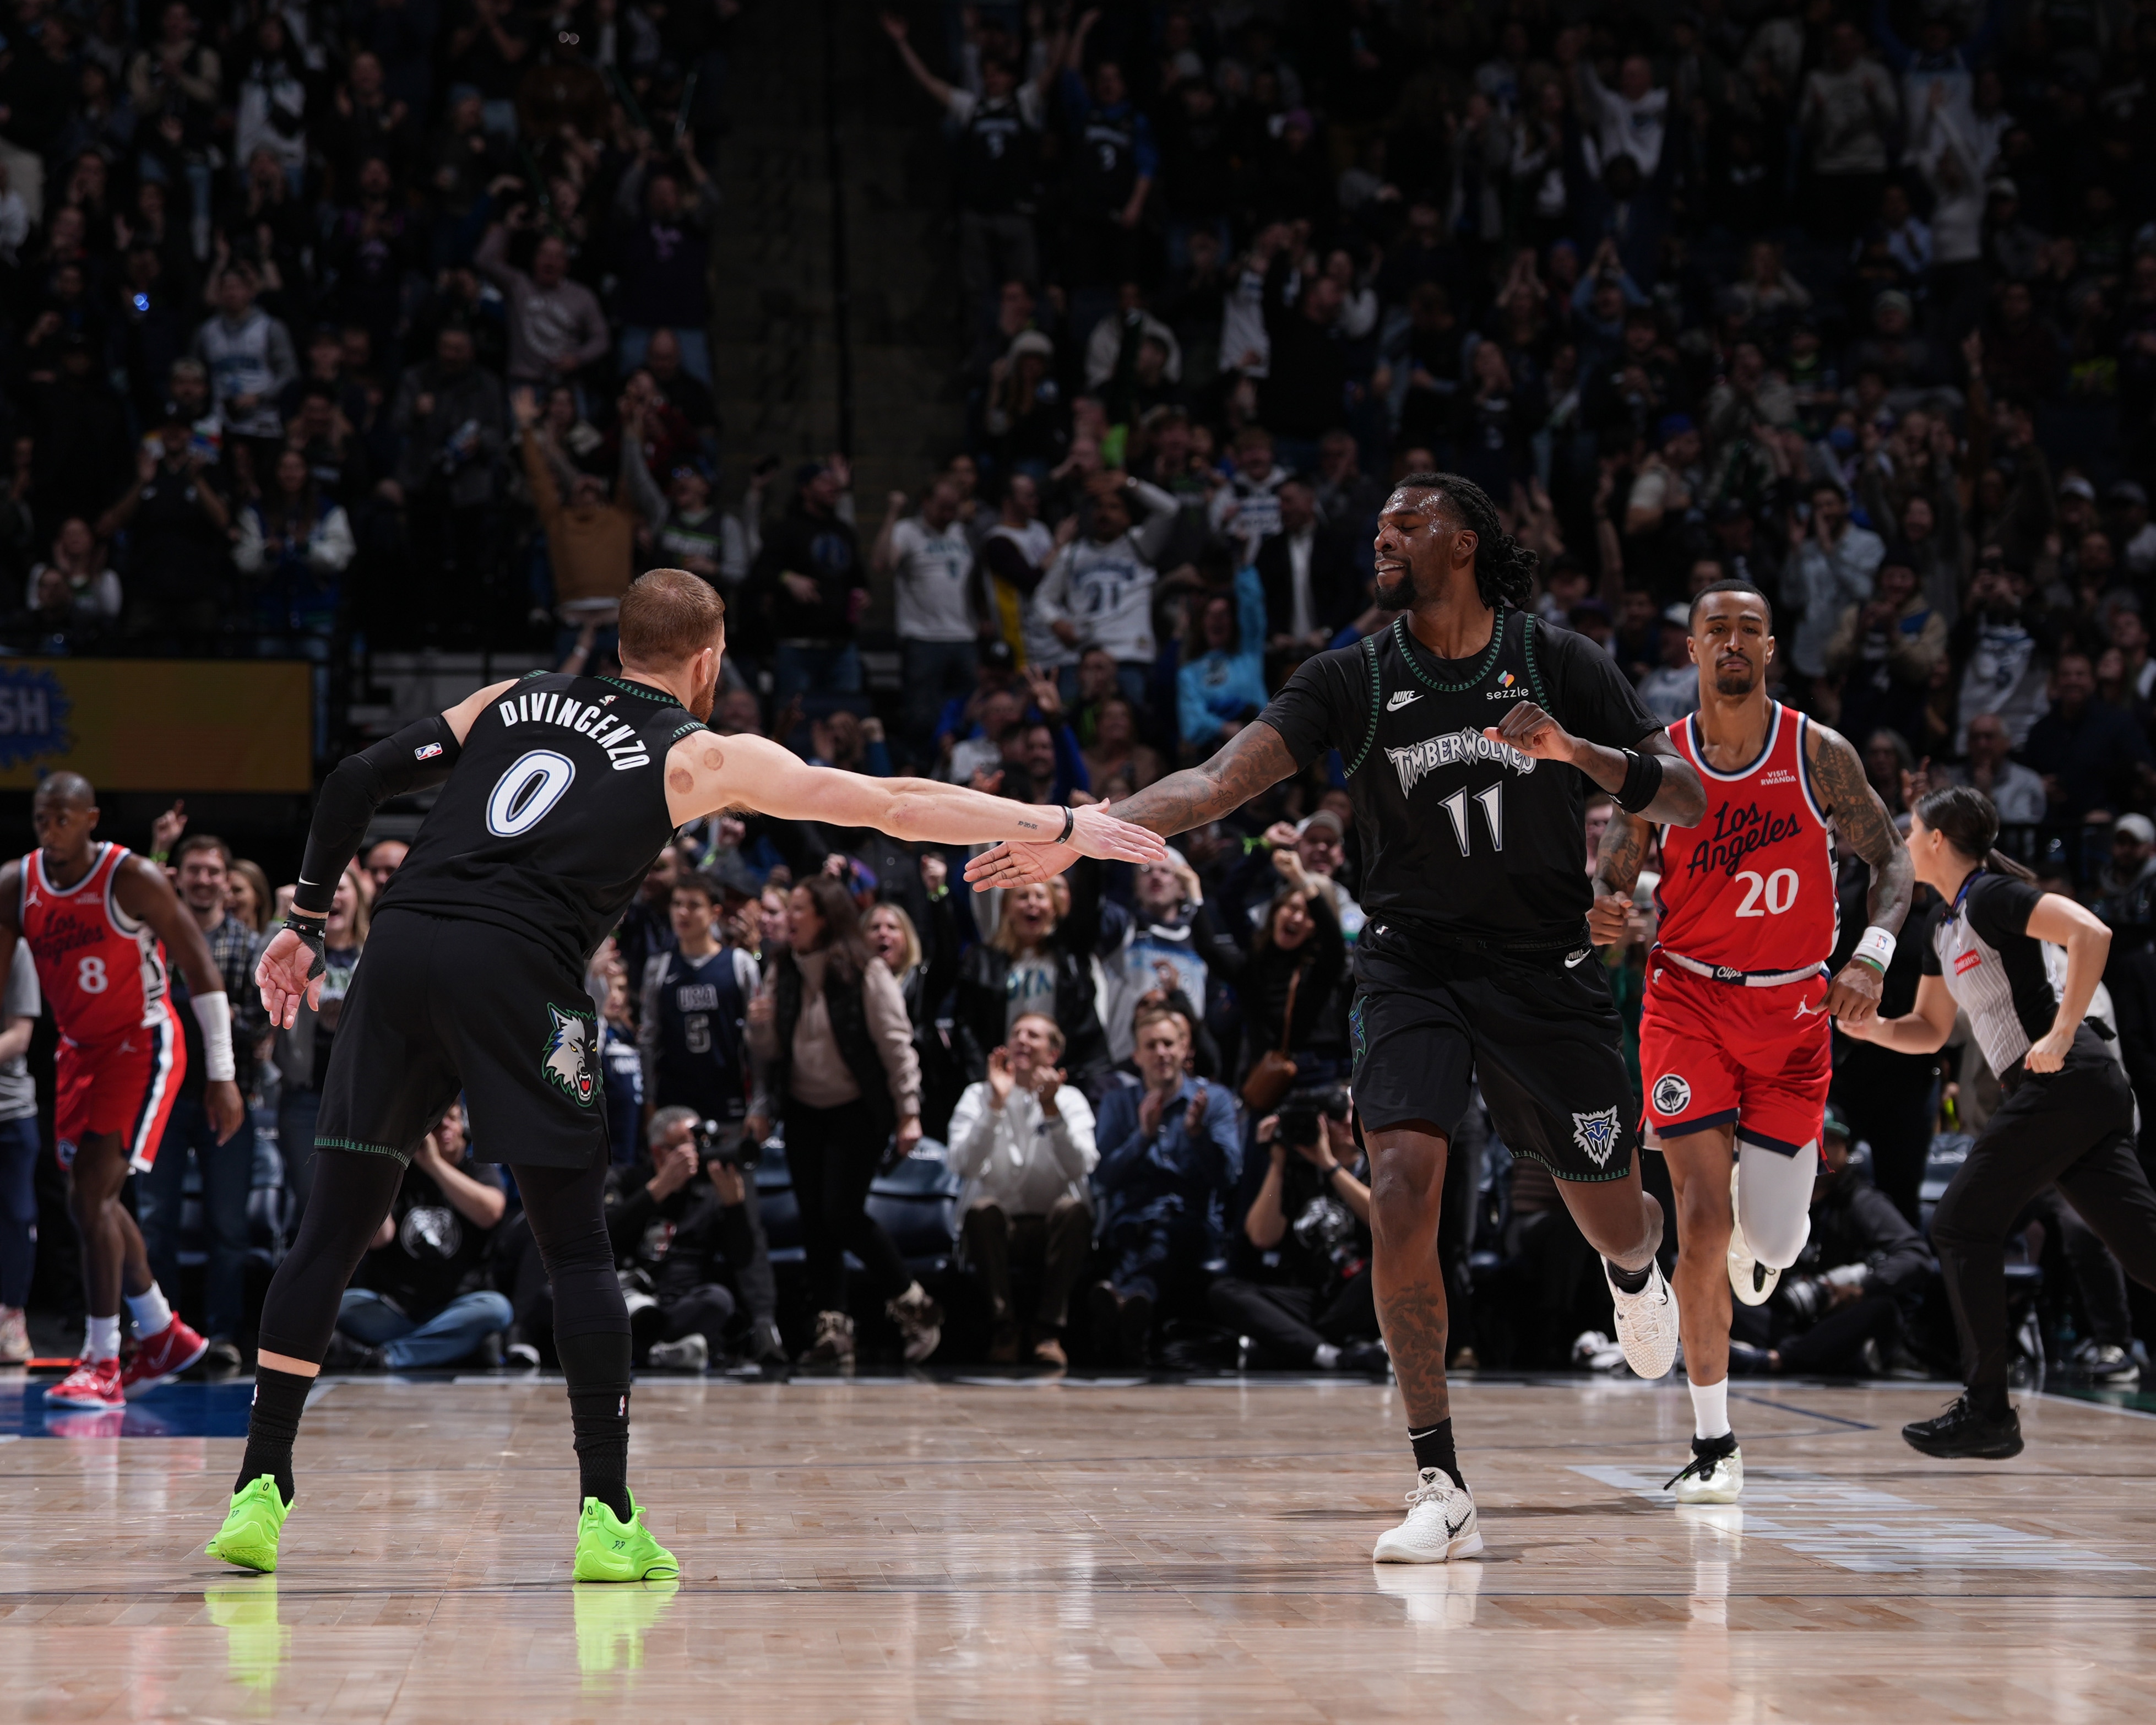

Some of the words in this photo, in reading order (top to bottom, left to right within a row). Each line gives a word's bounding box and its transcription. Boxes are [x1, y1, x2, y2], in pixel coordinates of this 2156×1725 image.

[1392, 690, 1415, 703] NIKE
[1486, 686, 1529, 700] sezzle
[499, 692, 650, 771] DIVINCENZO
[486, 749, 576, 838] 0
[1761, 774, 1797, 786] RWANDA
[1767, 769, 1788, 778] VISIT
[1437, 780, 1503, 858] 11
[1713, 800, 1763, 843] Los
[1687, 810, 1803, 880] Angeles
[1735, 867, 1799, 918] 20
[77, 955, 108, 995] 8
[1717, 965, 1744, 980] Clips
[676, 982, 719, 1012] USA
[684, 1013, 712, 1054] 5
